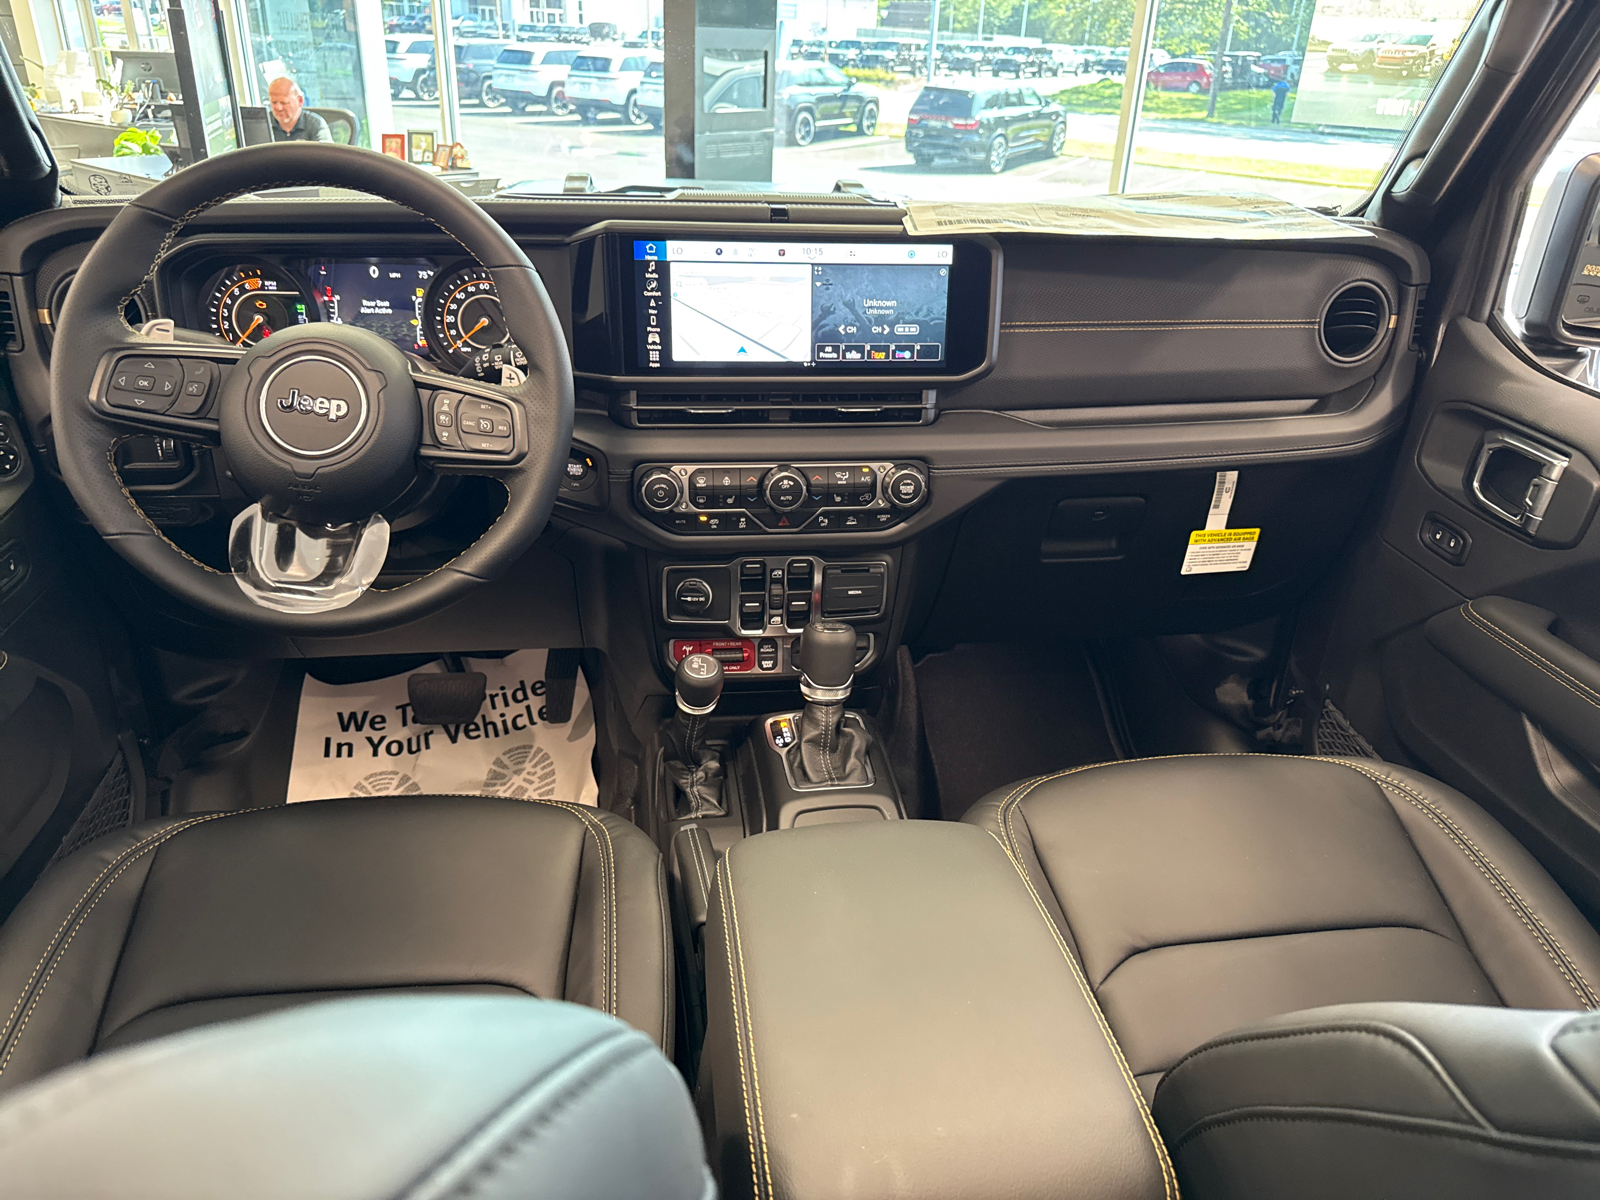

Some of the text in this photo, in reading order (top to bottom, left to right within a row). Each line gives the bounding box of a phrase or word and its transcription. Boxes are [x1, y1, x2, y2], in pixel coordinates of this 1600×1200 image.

[369, 265, 379, 279] 0
[455, 292, 466, 300] 40
[226, 297, 232, 305] 4
[863, 298, 897, 307] Unknown
[222, 309, 229, 317] 3
[375, 307, 393, 315] Active
[446, 315, 455, 323] 20
[223, 321, 230, 329] 2
[138, 379, 149, 387] OK
[277, 388, 349, 422] Jeep
[336, 710, 387, 733] We
[489, 680, 546, 710] ride
[323, 736, 354, 758] In
[365, 729, 434, 758] Your
